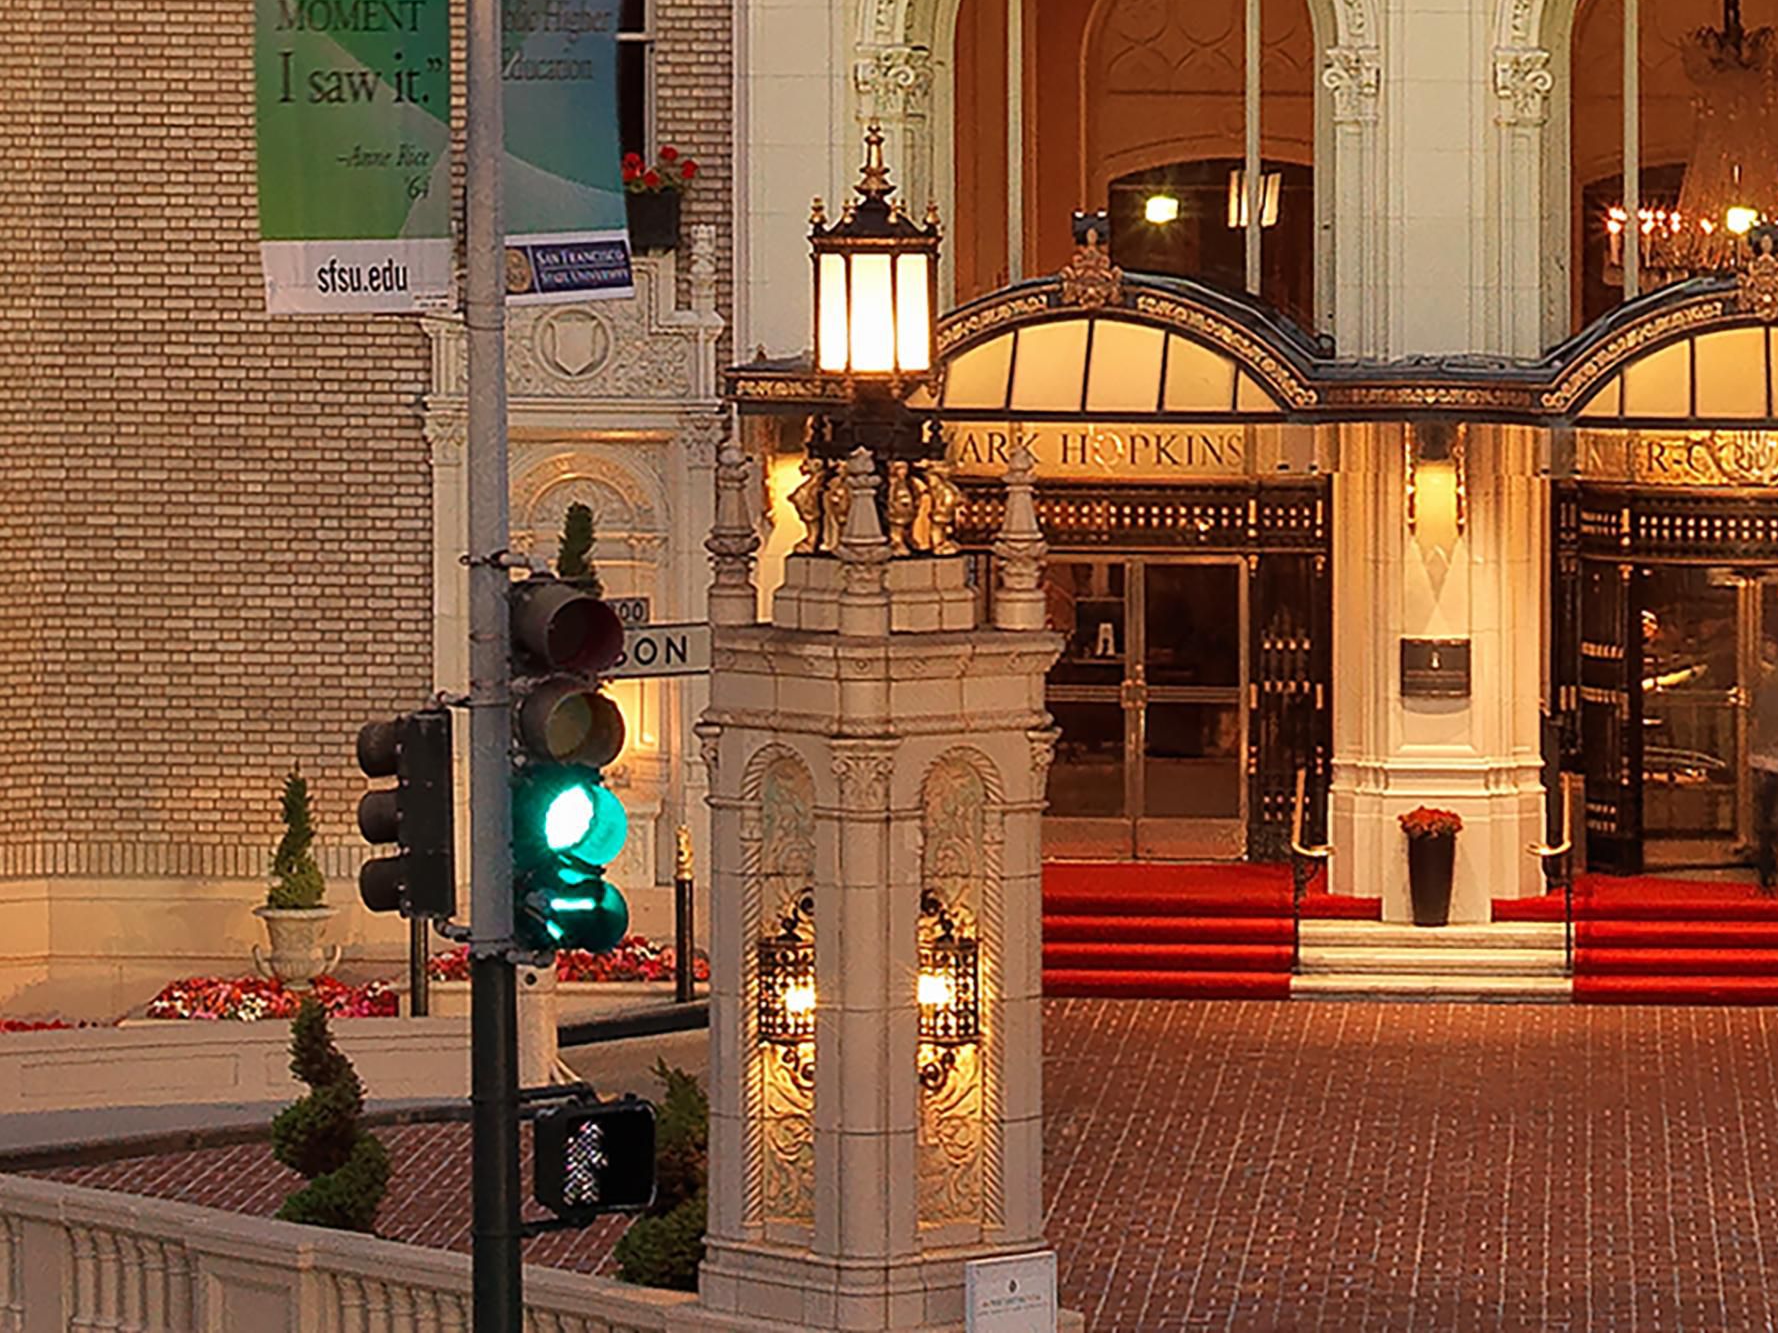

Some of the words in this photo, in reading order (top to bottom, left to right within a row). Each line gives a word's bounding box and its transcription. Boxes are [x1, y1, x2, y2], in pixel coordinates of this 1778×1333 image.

[278, 50, 294, 103] I
[307, 68, 382, 104] saw
[317, 257, 408, 294] sfsu.edu
[950, 431, 1040, 465] ARK
[1061, 431, 1243, 467] HOPKINS
